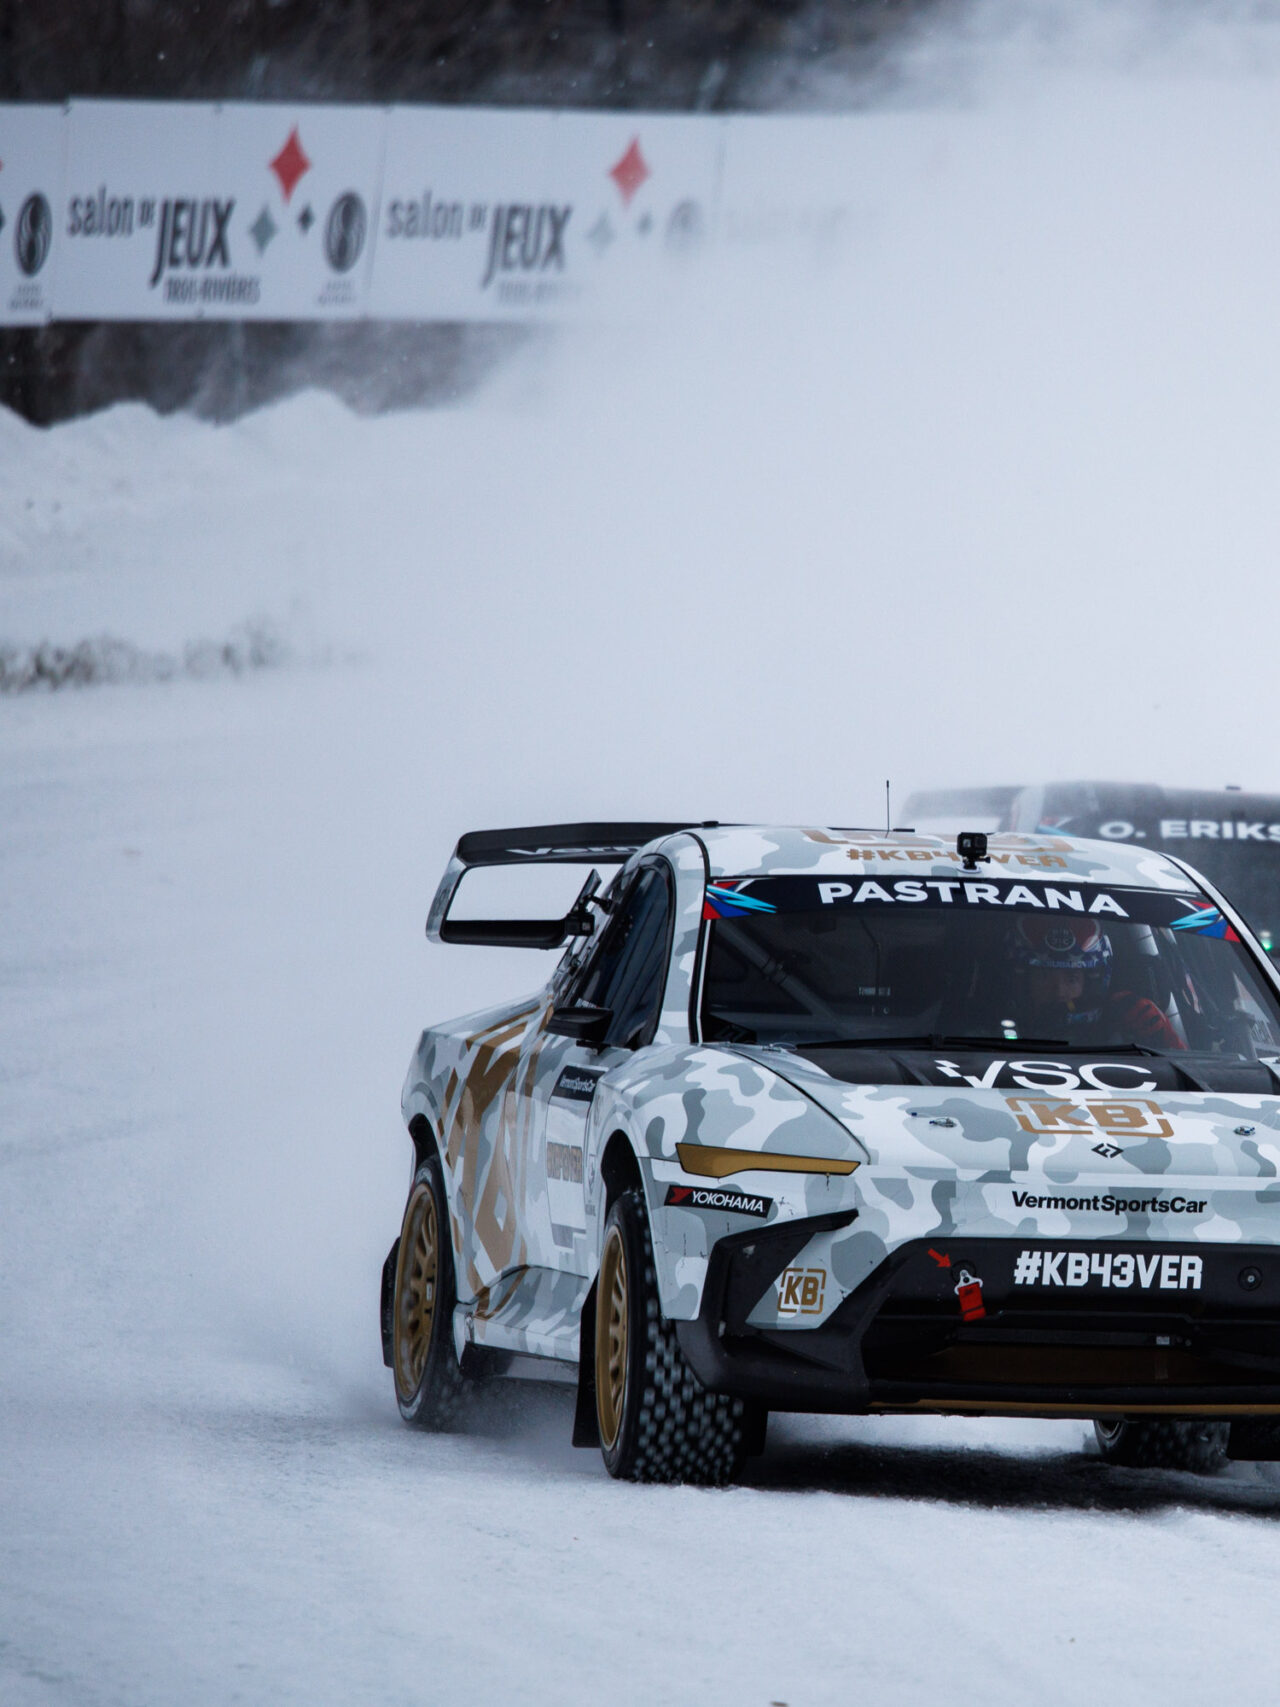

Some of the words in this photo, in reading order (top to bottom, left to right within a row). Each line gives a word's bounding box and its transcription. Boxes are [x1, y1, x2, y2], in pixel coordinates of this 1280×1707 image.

[68, 184, 134, 237] salon
[149, 198, 236, 289] JEUX
[387, 189, 462, 239] salon
[480, 204, 572, 289] JEUX
[1099, 820, 1147, 840] O.
[846, 847, 1067, 869] #KB4VER
[817, 880, 1130, 918] PASTRANA
[935, 1059, 1158, 1092] VSC
[1033, 1103, 1149, 1129] KB
[692, 1190, 764, 1213] YOKOHAMA
[1012, 1190, 1208, 1216] VermontSportsCar
[1013, 1250, 1204, 1290] #KB43VER
[784, 1275, 819, 1306] KB
